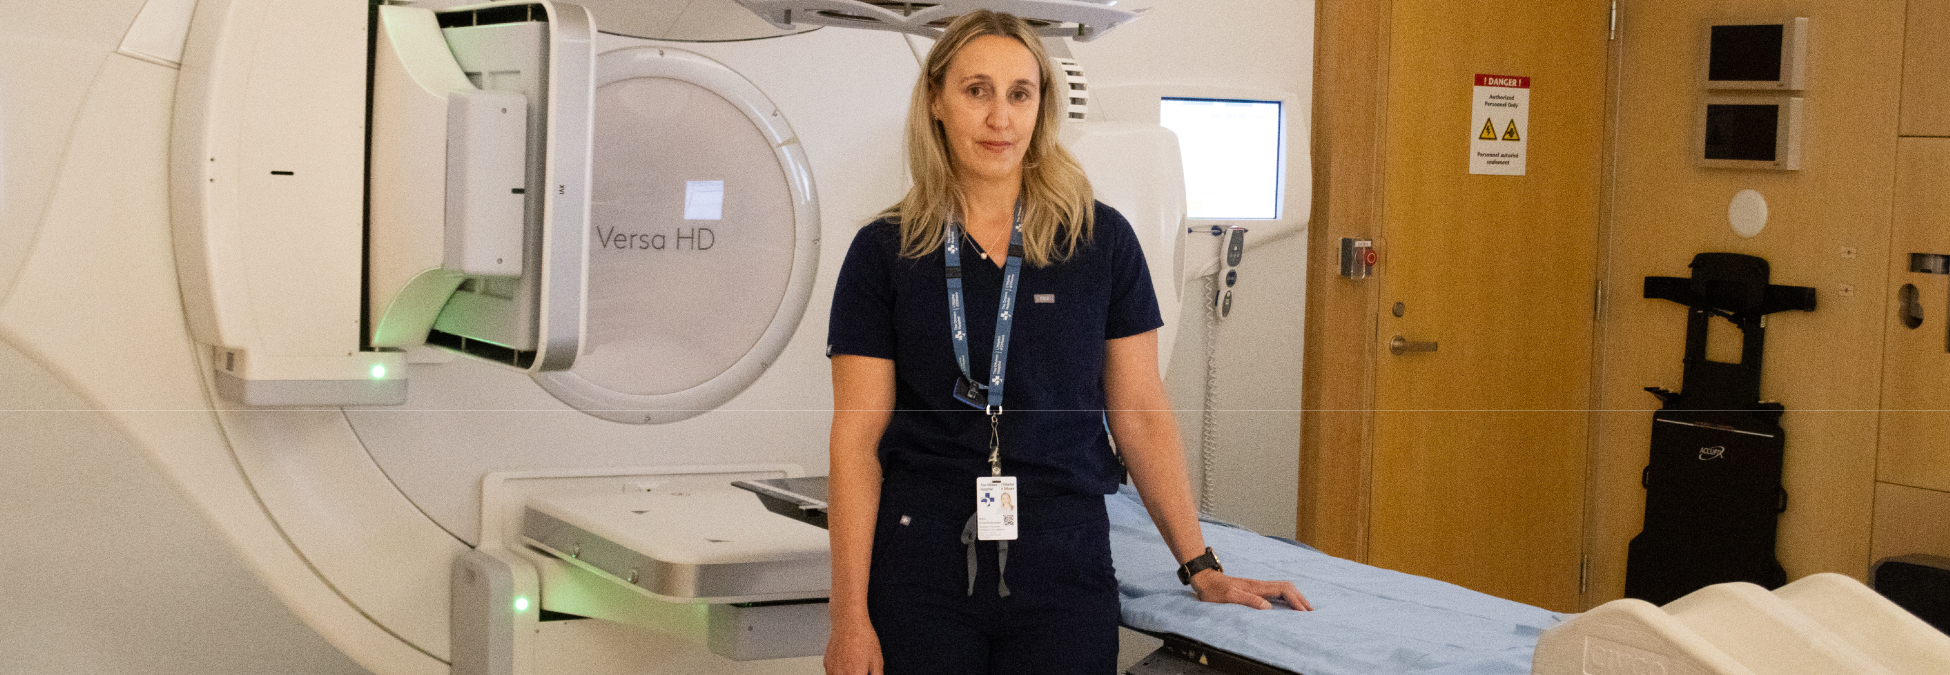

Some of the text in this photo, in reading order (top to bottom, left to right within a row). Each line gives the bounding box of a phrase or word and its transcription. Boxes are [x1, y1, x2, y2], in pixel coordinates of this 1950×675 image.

[1488, 77, 1517, 87] DANGER
[596, 226, 715, 250] Versa HD
